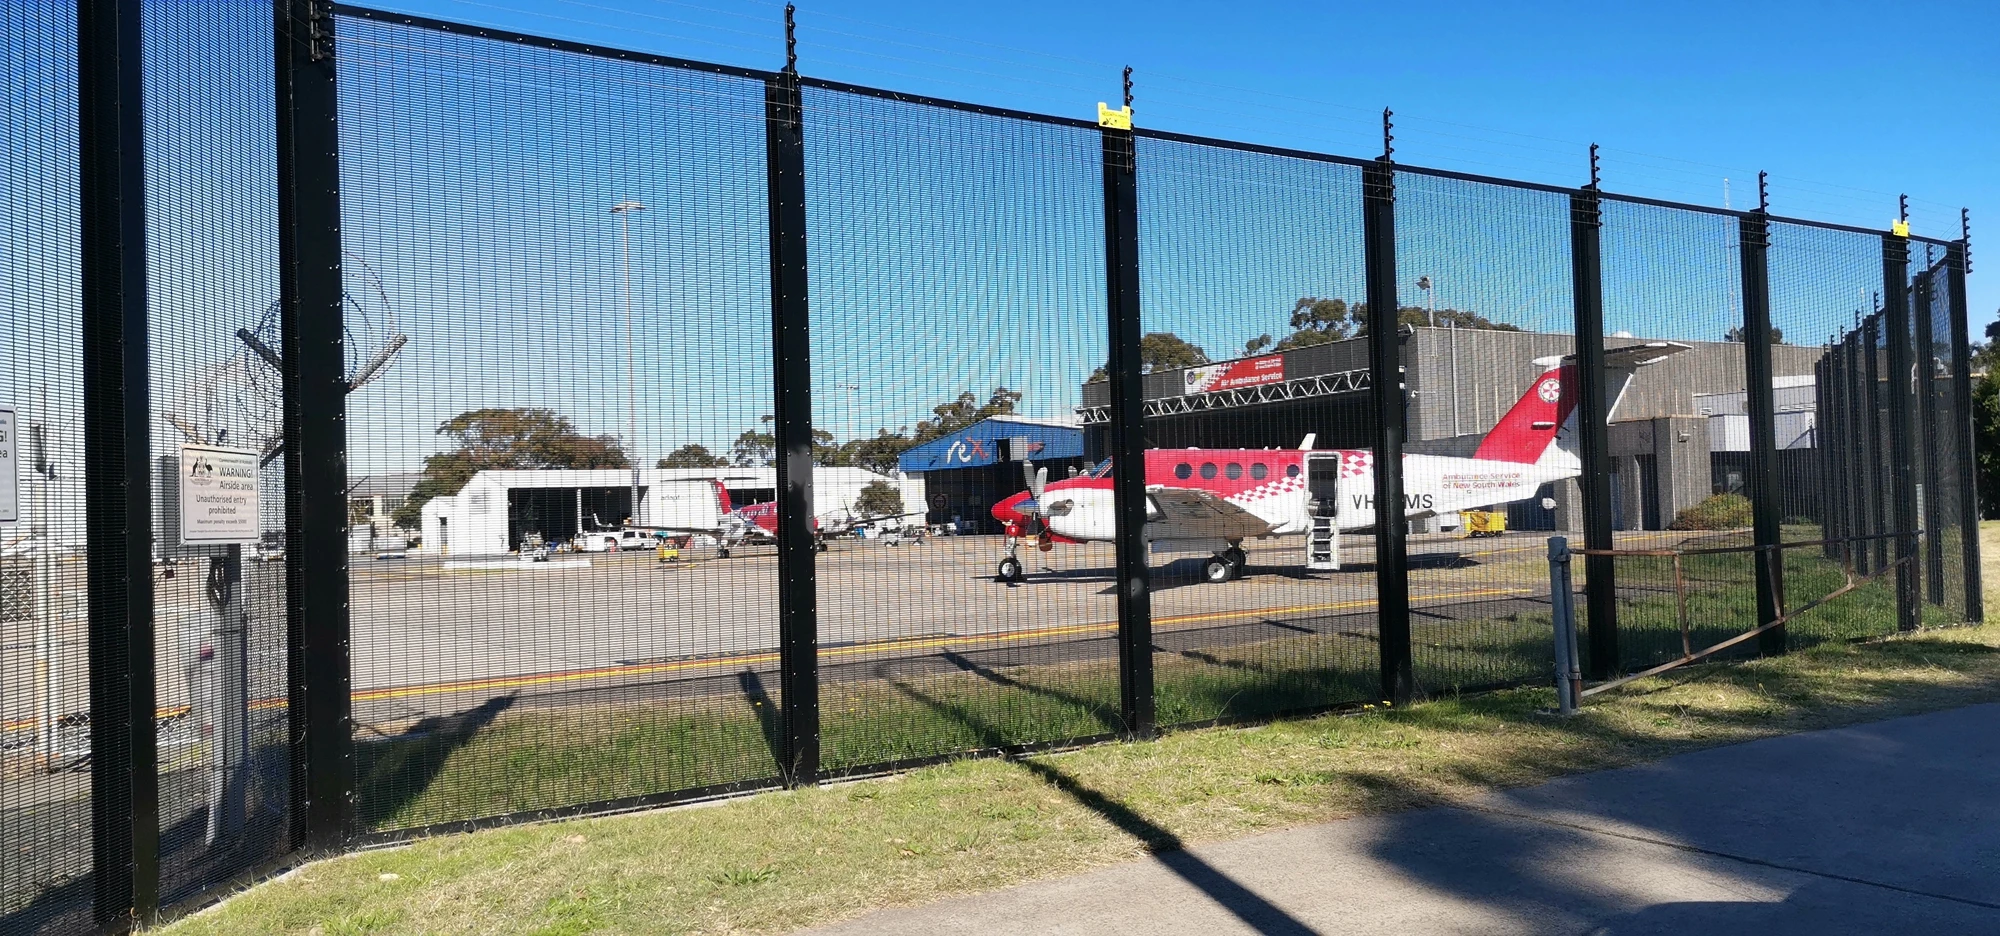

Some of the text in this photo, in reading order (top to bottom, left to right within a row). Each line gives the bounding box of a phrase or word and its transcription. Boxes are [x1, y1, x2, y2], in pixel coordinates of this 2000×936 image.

[219, 467, 254, 478] WARNING!
[220, 480, 240, 490] Airside
[241, 483, 254, 491] area
[1473, 481, 1495, 489] South
[196, 494, 247, 505] Unauthorised entry
[209, 505, 236, 516] prohibited
